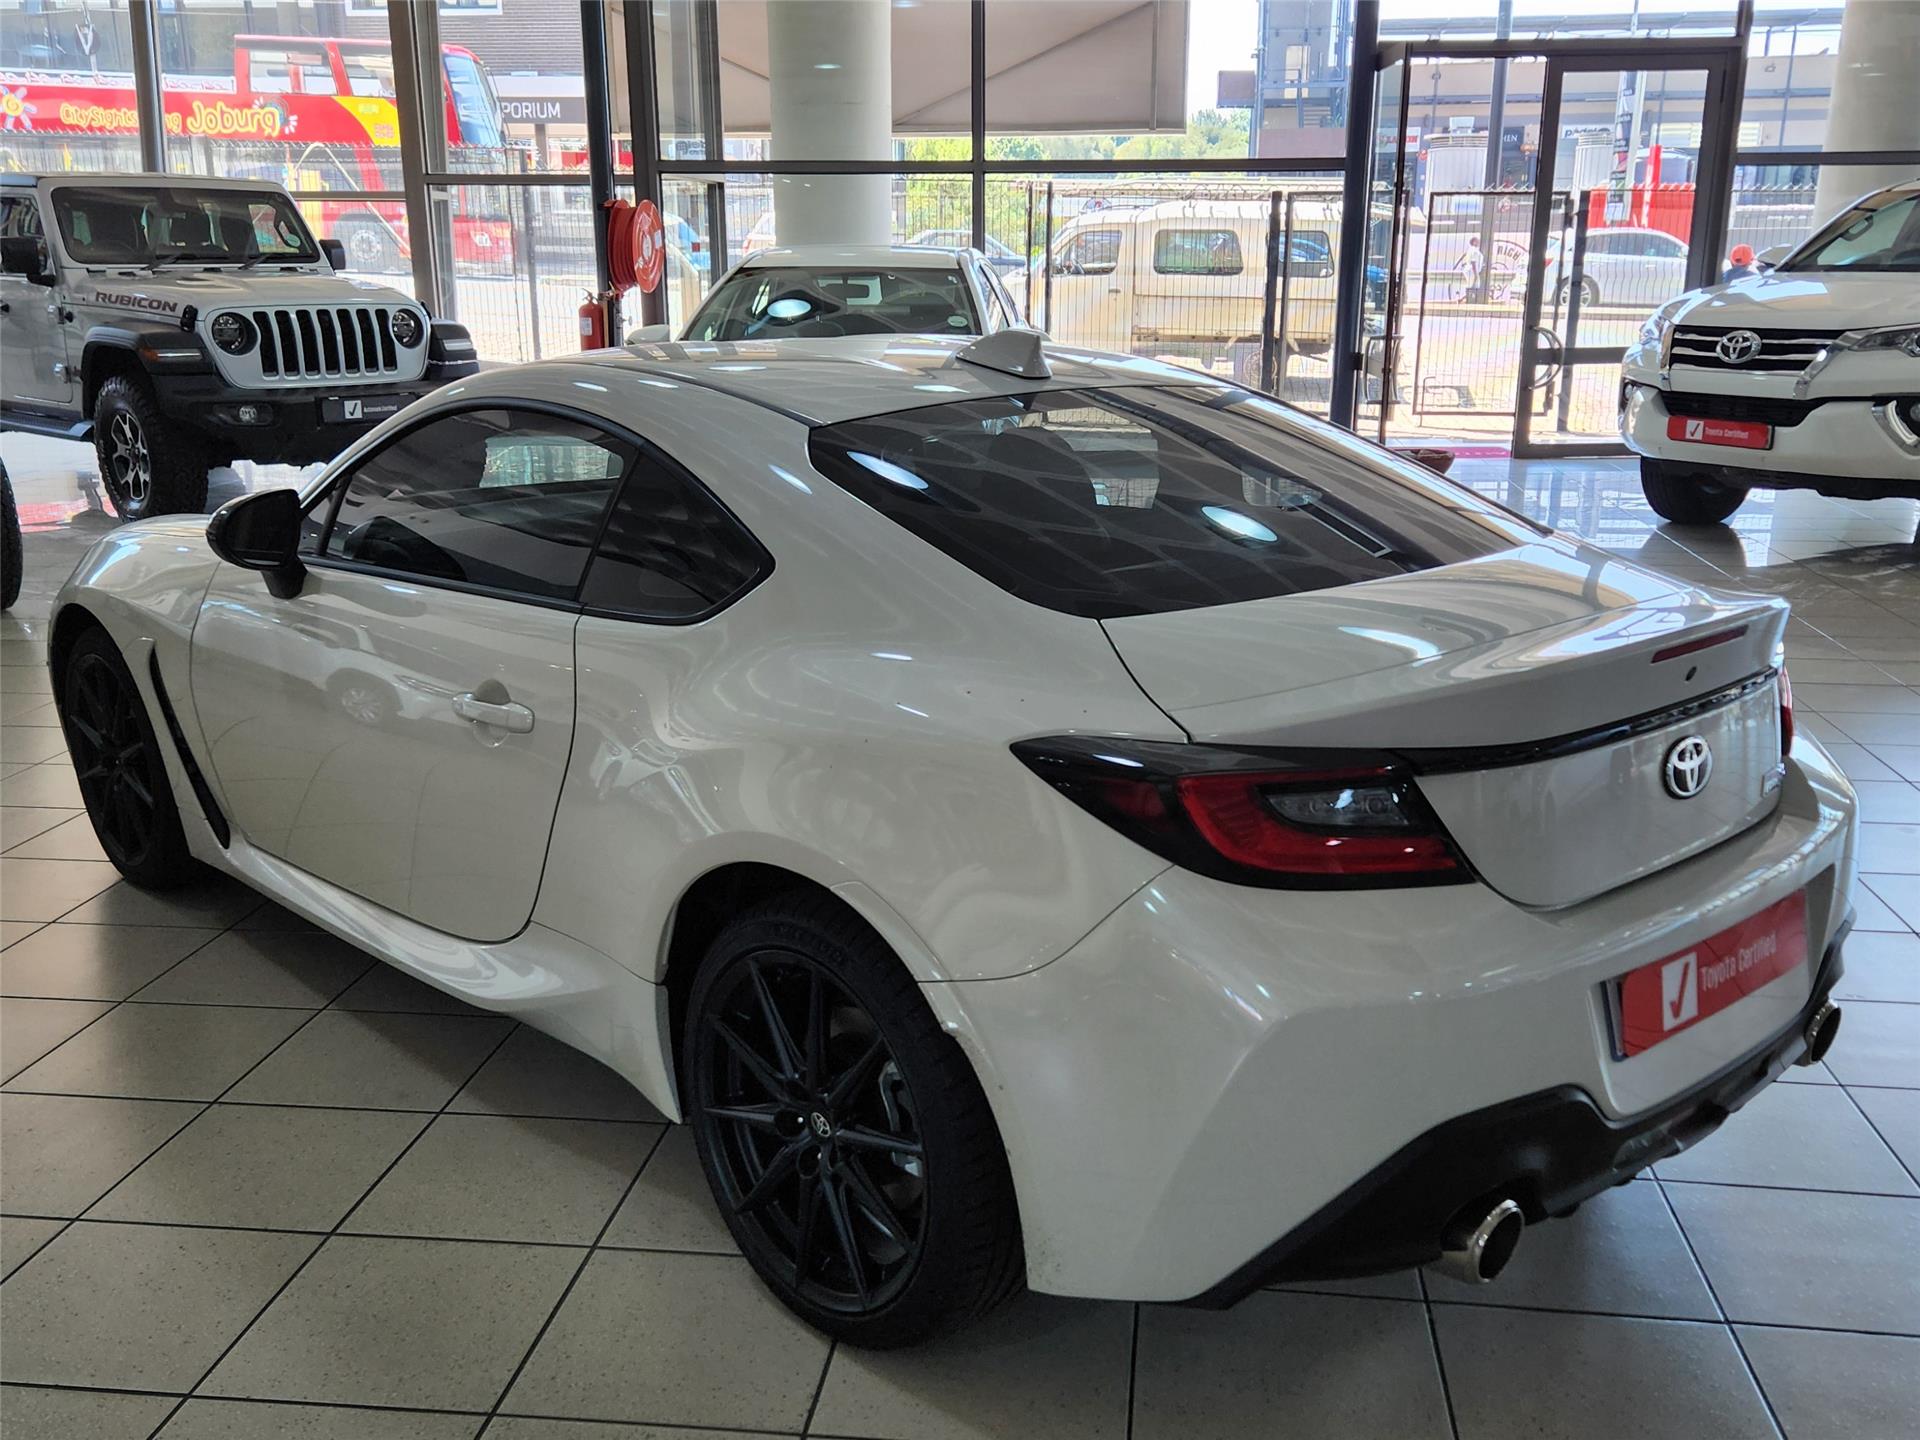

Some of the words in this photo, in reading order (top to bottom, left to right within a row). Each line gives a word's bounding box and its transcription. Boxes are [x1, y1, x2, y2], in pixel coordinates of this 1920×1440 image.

[186, 100, 281, 137] Joburg
[95, 291, 178, 312] RUBICON
[1705, 426, 1724, 437] Toyota
[1724, 429, 1748, 439] Certified
[1701, 956, 1736, 991] Toyota
[1738, 930, 1776, 972] Certified
